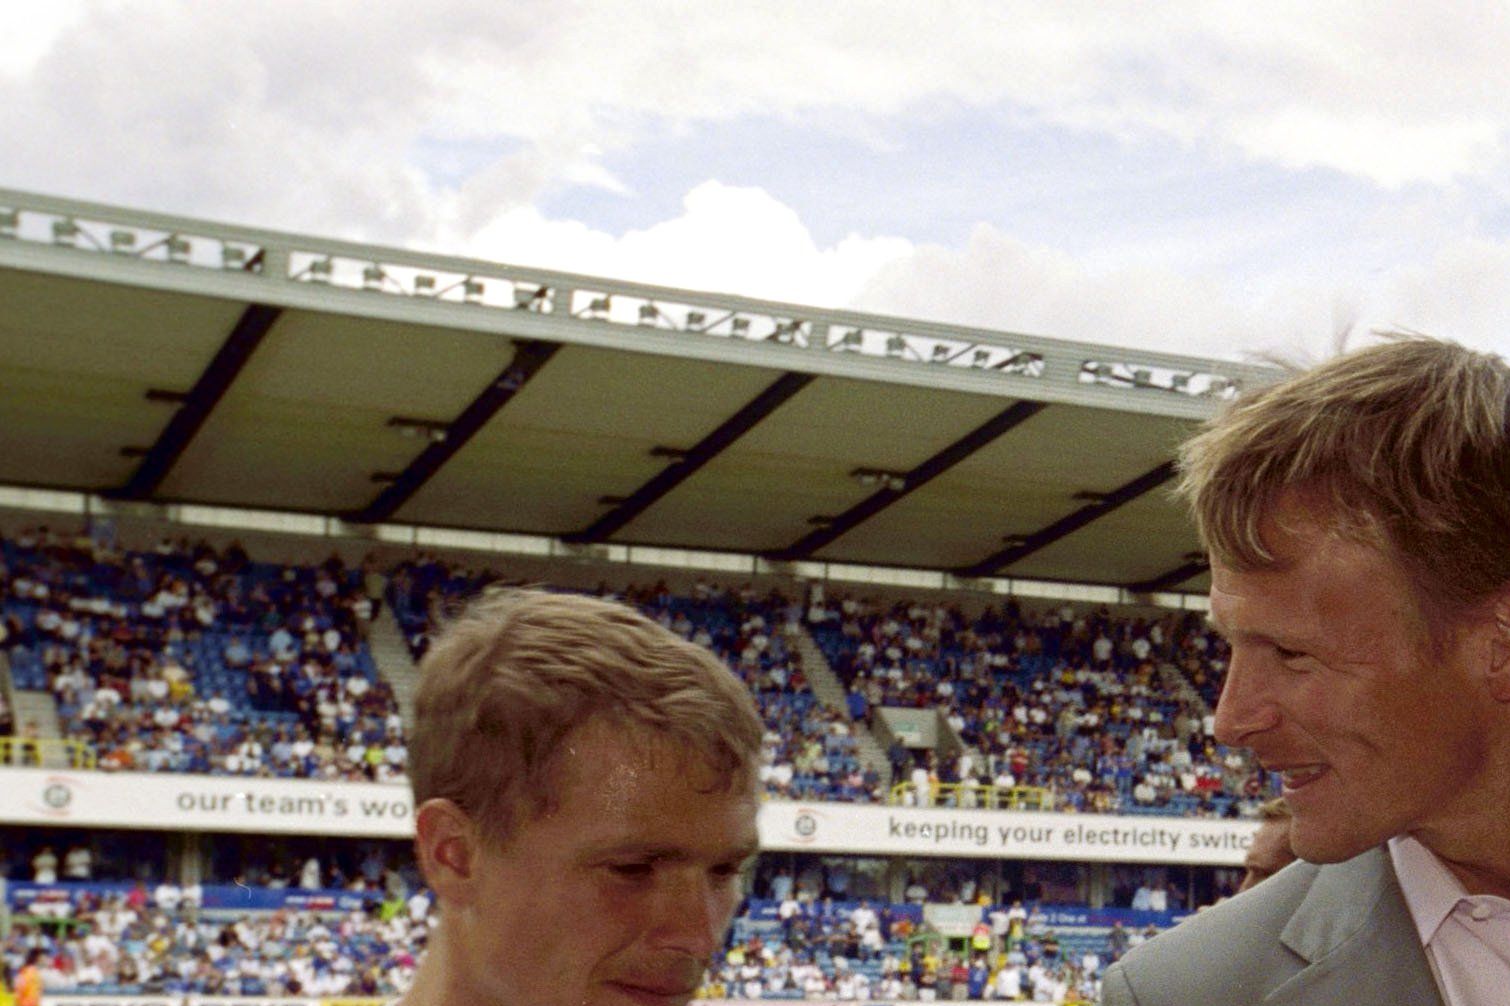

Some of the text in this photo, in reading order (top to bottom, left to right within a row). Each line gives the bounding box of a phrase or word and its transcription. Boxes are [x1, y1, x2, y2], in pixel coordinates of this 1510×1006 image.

[178, 791, 408, 818] our team's wo
[888, 816, 1257, 851] keeping your electricity switc
